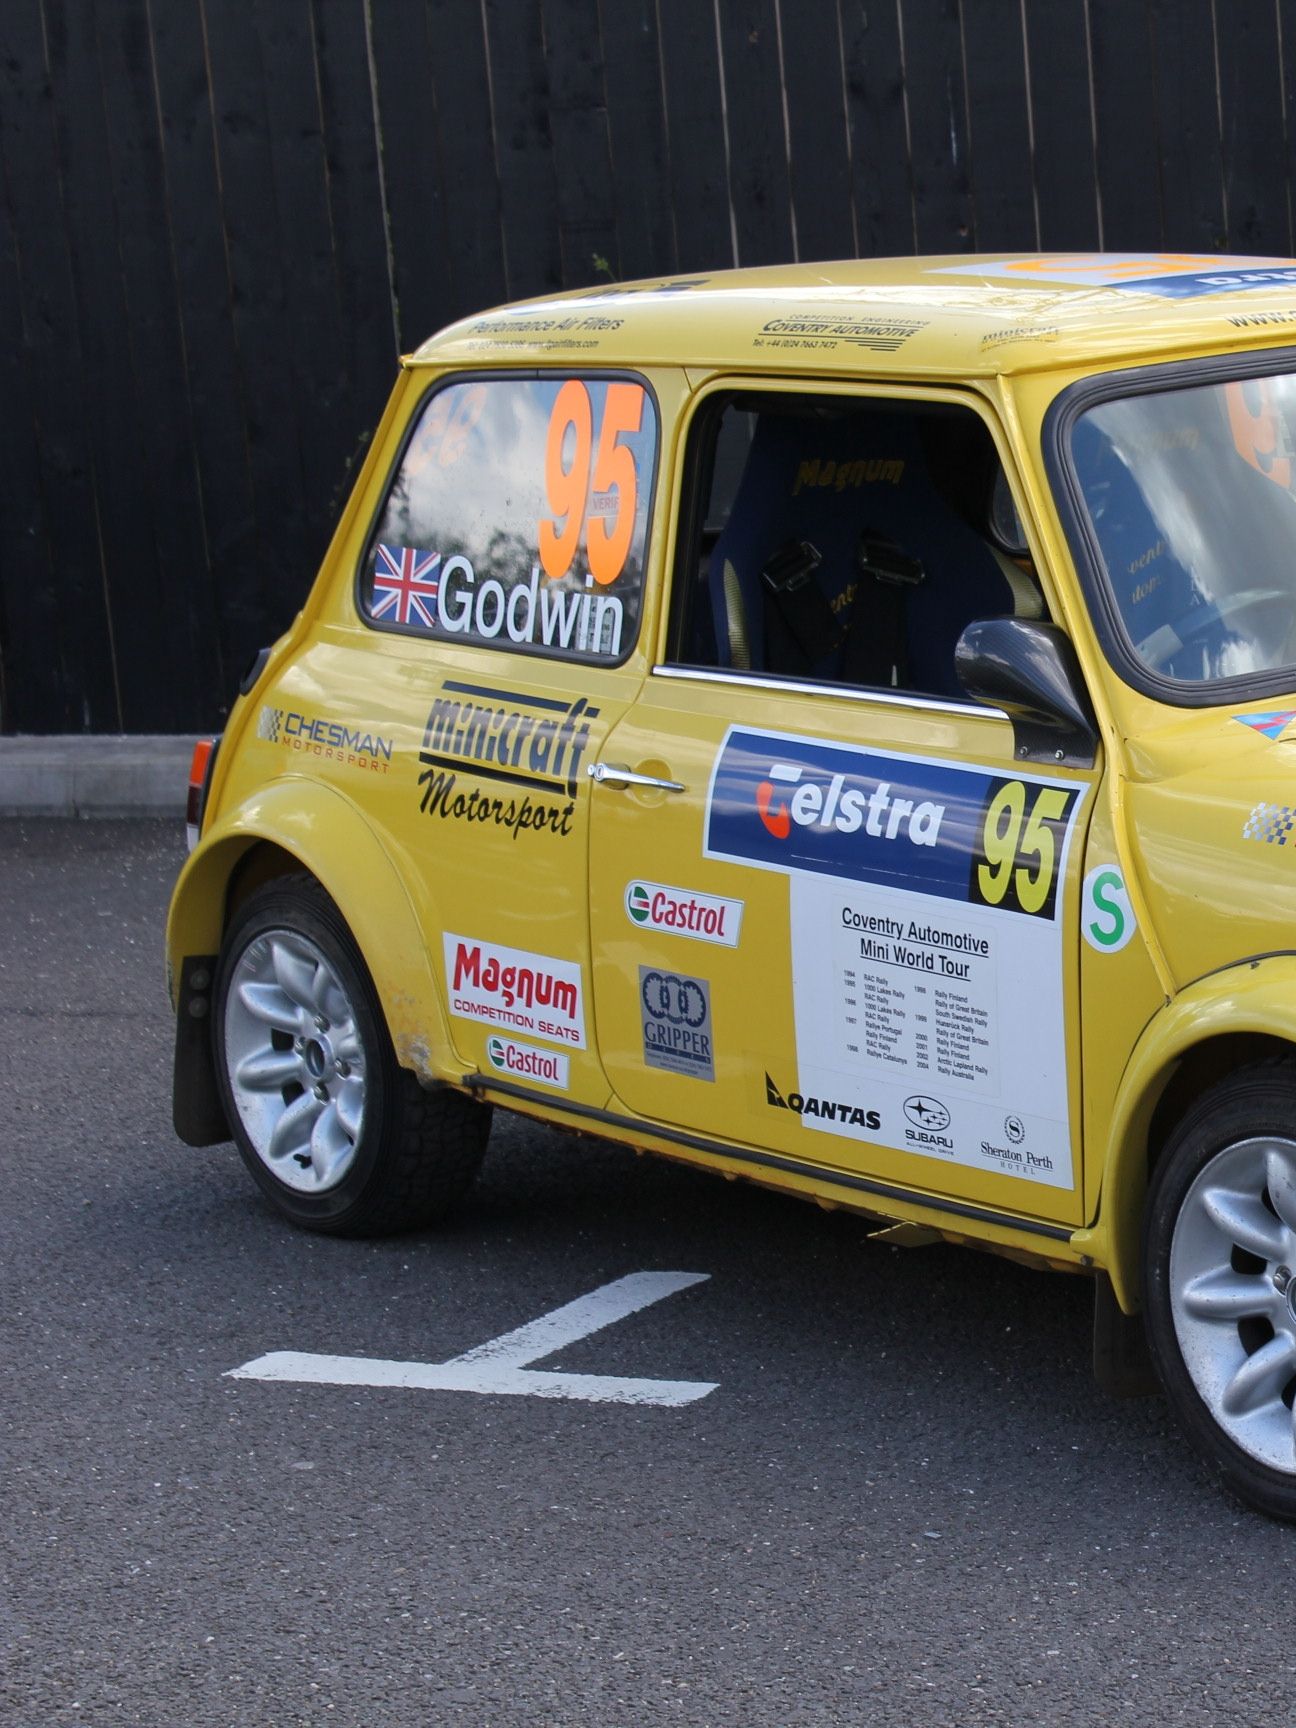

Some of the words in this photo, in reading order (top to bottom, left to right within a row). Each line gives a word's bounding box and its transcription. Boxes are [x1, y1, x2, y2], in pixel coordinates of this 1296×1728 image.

[467, 319, 555, 334] Performance
[556, 317, 579, 331] Air
[577, 316, 625, 331] Filters
[763, 319, 831, 333] COVENTRY
[830, 325, 920, 338] AUTOMOTIVE
[861, 316, 931, 326] ENGINEERING
[538, 379, 645, 585] 95
[438, 555, 623, 656] Godwin
[284, 712, 394, 760] CHESMAN
[282, 736, 390, 774] MOTORSPORT
[421, 697, 592, 799] minicraft
[418, 769, 575, 840] Motorsport
[756, 764, 945, 847] Telstra
[977, 780, 1070, 913] 95
[652, 891, 725, 937] Castrol
[1089, 872, 1125, 946] S
[842, 907, 904, 939] Coventry
[908, 921, 989, 955] Automotive
[860, 938, 889, 960] Mini
[893, 946, 934, 971] World
[938, 958, 970, 978] Tour
[453, 943, 577, 1019] Magnum
[864, 974, 875, 982] RAC
[876, 977, 888, 986] Rally
[864, 984, 876, 992] 1000
[877, 986, 891, 995] Lakes
[892, 990, 905, 1000] Rally
[864, 993, 876, 1001] RAC
[877, 995, 888, 1005] Rally
[935, 990, 947, 1000] Rally
[949, 993, 968, 1003] Finland
[865, 1012, 876, 1020] RAC
[877, 1014, 889, 1024] Rally
[878, 1006, 892, 1014] Lakes
[893, 1009, 905, 1018] Rally
[935, 1000, 947, 1009] Rally
[956, 1005, 969, 1013] Great
[971, 1007, 988, 1017] Britain
[454, 999, 534, 1029] COMPETITION
[538, 1020, 580, 1042] SEATS
[866, 1021, 880, 1030] Rallye
[882, 1024, 902, 1035] Portugal
[936, 1009, 950, 1018] South
[952, 1013, 973, 1023] Swedish
[974, 1018, 987, 1028] Rally
[644, 1021, 710, 1056] GRIPPER
[866, 1030, 878, 1040] Rally
[879, 1033, 897, 1043] Finland
[936, 1028, 948, 1038] Rally
[956, 1033, 970, 1042] Great
[972, 1036, 989, 1046] Britain
[961, 1024, 974, 1034] Rally
[866, 1040, 877, 1048] RAC
[878, 1042, 890, 1052] Rally
[937, 1037, 949, 1047] Rally
[950, 1040, 969, 1051] Finland
[937, 1047, 949, 1057] Rally
[951, 1050, 970, 1060] Finland
[505, 1045, 559, 1081] Castrol
[867, 1049, 881, 1059] Rallye
[938, 1057, 952, 1065] Arctic
[953, 1060, 973, 1071] Lapland
[975, 1065, 988, 1076] Rally
[938, 1066, 950, 1076] Rally
[952, 1070, 974, 1080] Australia
[787, 1093, 881, 1131] QANTAS
[905, 1129, 953, 1149] SUBARU
[980, 1141, 1022, 1162] Sheraton
[1026, 1151, 1053, 1169] Perth
[1000, 1161, 1035, 1175] HOTEL
